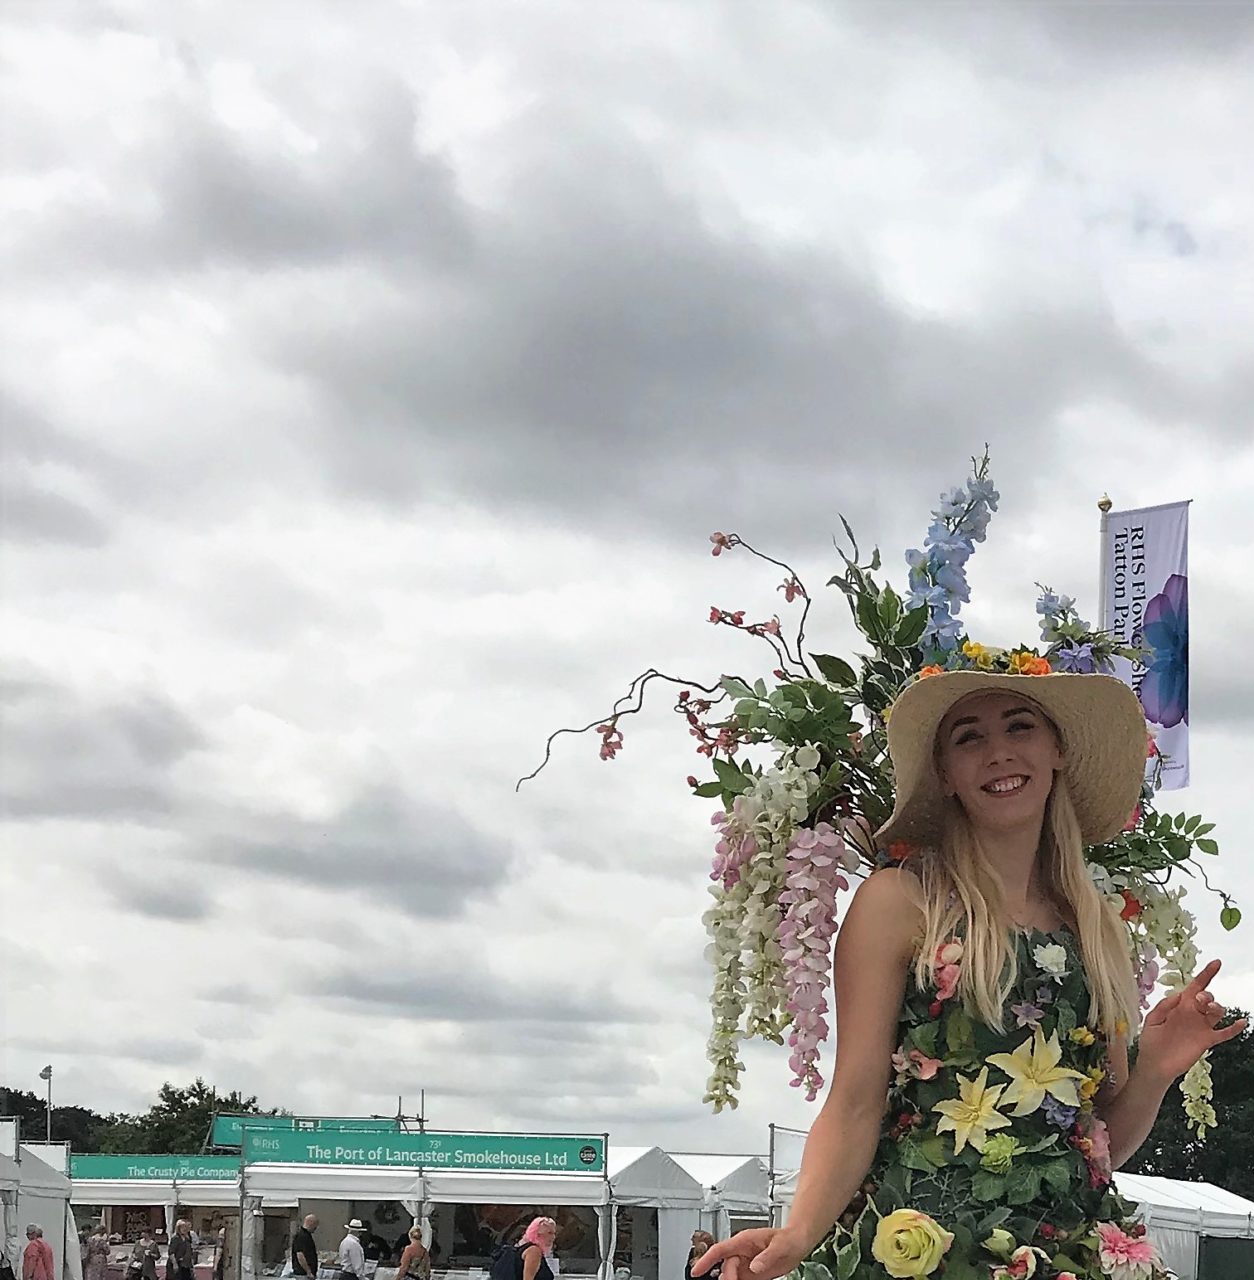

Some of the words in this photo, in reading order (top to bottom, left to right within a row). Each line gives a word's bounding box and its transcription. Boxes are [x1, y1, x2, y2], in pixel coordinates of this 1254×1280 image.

[1115, 527, 1129, 599] Tatton
[1131, 526, 1146, 576] RHS
[1131, 581, 1146, 650] Flowe
[1131, 660, 1147, 703] Sho
[262, 1138, 280, 1150] RHS
[306, 1145, 332, 1159] The
[335, 1146, 365, 1160] Port
[367, 1147, 382, 1160] of
[386, 1148, 451, 1164] Lancaster
[454, 1150, 541, 1166] Smokehouse
[545, 1152, 568, 1166] Ltd
[127, 1166, 146, 1176] The
[148, 1166, 179, 1179] Crusty
[180, 1166, 196, 1176] Pie
